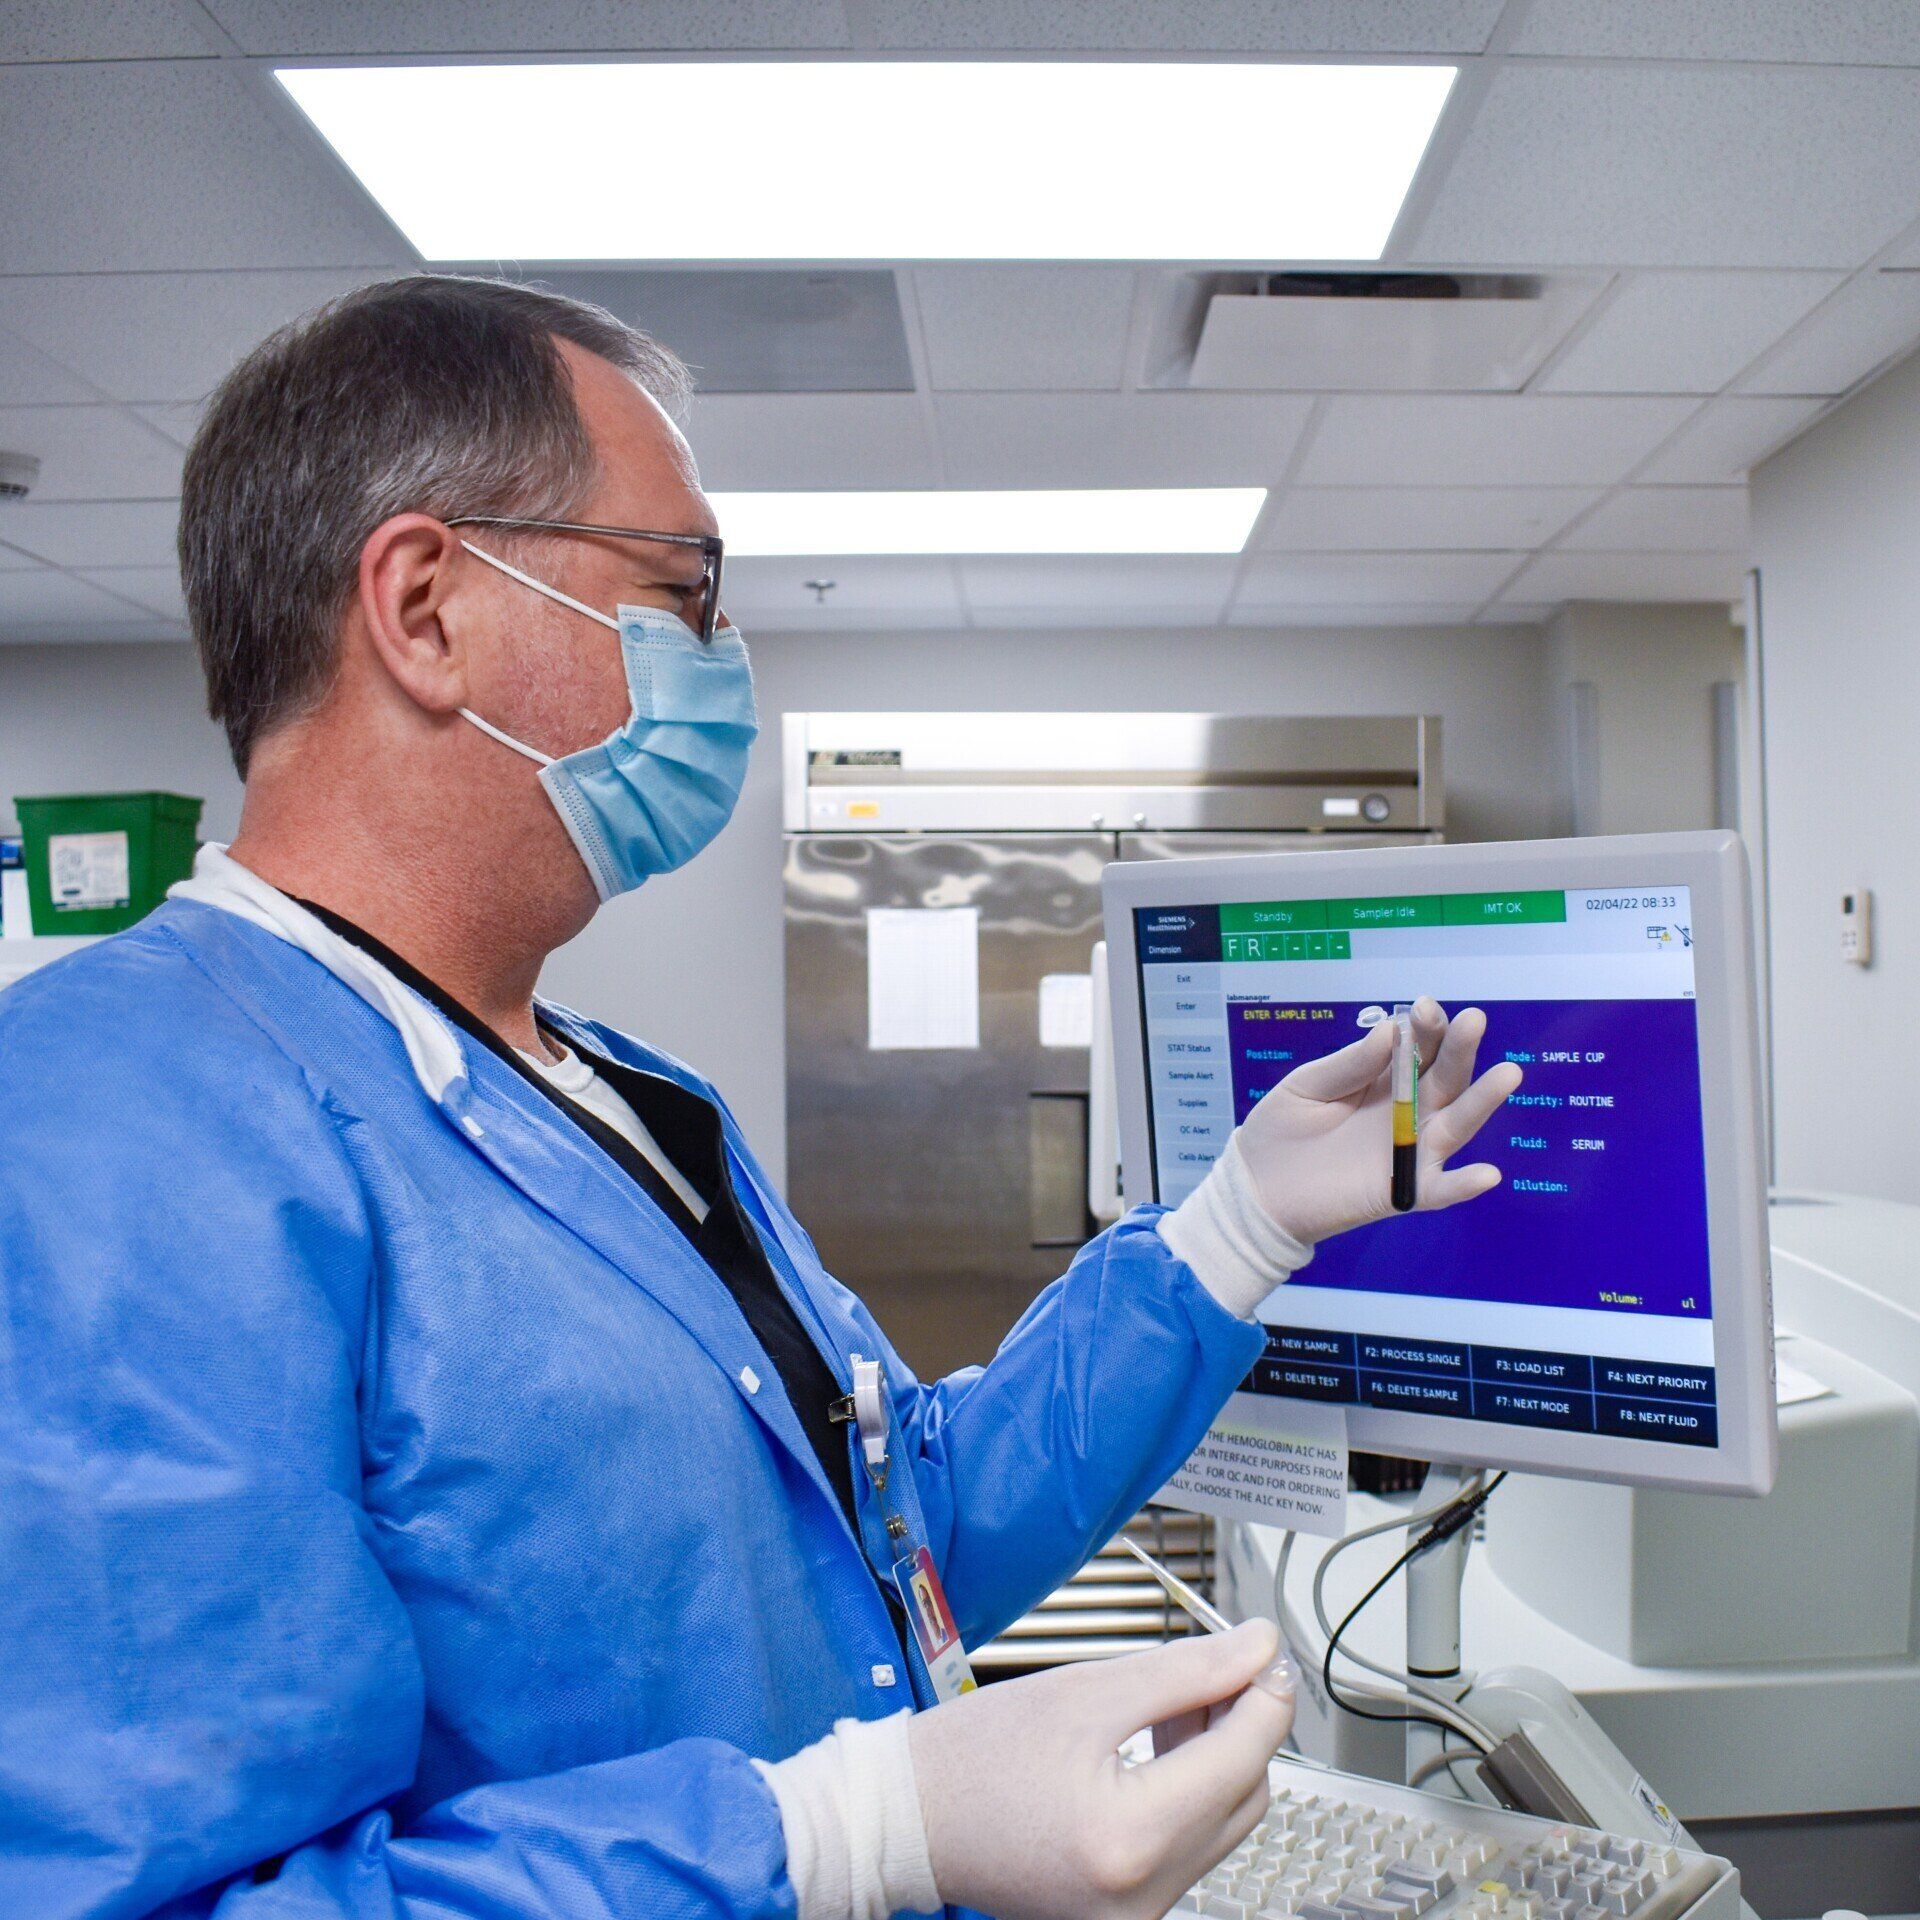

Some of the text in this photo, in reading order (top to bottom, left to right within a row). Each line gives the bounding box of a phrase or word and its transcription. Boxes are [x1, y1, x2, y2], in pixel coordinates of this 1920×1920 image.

[1484, 902, 1522, 914] IMT OK
[1586, 896, 1676, 911] 02/04/22 08:33
[1254, 911, 1292, 923] Standby
[1353, 906, 1416, 919] Sampler Idle
[1148, 945, 1182, 954] Dimension
[1176, 974, 1191, 983] Exit
[1226, 994, 1271, 1003] labmanager
[1176, 1002, 1196, 1011] Enter
[1243, 1009, 1334, 1020] ENTER SAMPLE DATA
[1167, 1044, 1212, 1053] STAT Status
[1245, 1048, 1293, 1059] Position:
[1506, 1051, 1606, 1063] Mode: SAMPLE CUP
[1168, 1071, 1214, 1081] Sample Alert
[1248, 1088, 1268, 1099] Pat
[1178, 1098, 1208, 1108] Supplies
[1508, 1094, 1614, 1108] Priority: ROUTINE
[1180, 1125, 1210, 1135] QC Alert
[1510, 1136, 1605, 1150] Fluid: SERUM
[1197, 1152, 1216, 1162] Alert
[1513, 1179, 1568, 1192] Dilution:
[1599, 1291, 1643, 1306] Volume:
[1281, 1337, 1302, 1349] NEW
[1303, 1339, 1340, 1354] SAMPLE
[1365, 1346, 1461, 1366] F2: PROCESS SINGLE
[1496, 1359, 1565, 1377] F3: LOAD LIST
[1284, 1372, 1317, 1385] DELETE
[1317, 1376, 1340, 1387] TEST
[1608, 1371, 1708, 1391] F4: NEXT PRIORITY
[1371, 1381, 1459, 1402] F6: DELETE SAMPLE
[1496, 1395, 1570, 1414] F7: NEXT MODE
[1620, 1409, 1698, 1428] F8: NEXT FLUID
[1208, 1429, 1338, 1462] THE HEMOGLOBIN A1C HAS
[1193, 1446, 1343, 1481] OR INTERFACE PURPOSES FROM
[1206, 1465, 1226, 1479] FOR
[1226, 1469, 1241, 1482] QC
[1243, 1472, 1265, 1486] AND
[1266, 1476, 1287, 1490] FOR
[1288, 1481, 1341, 1500] ORDERING
[1168, 1477, 1326, 1516] ALLY, CHOOSE THE A1C KEY NOW.
